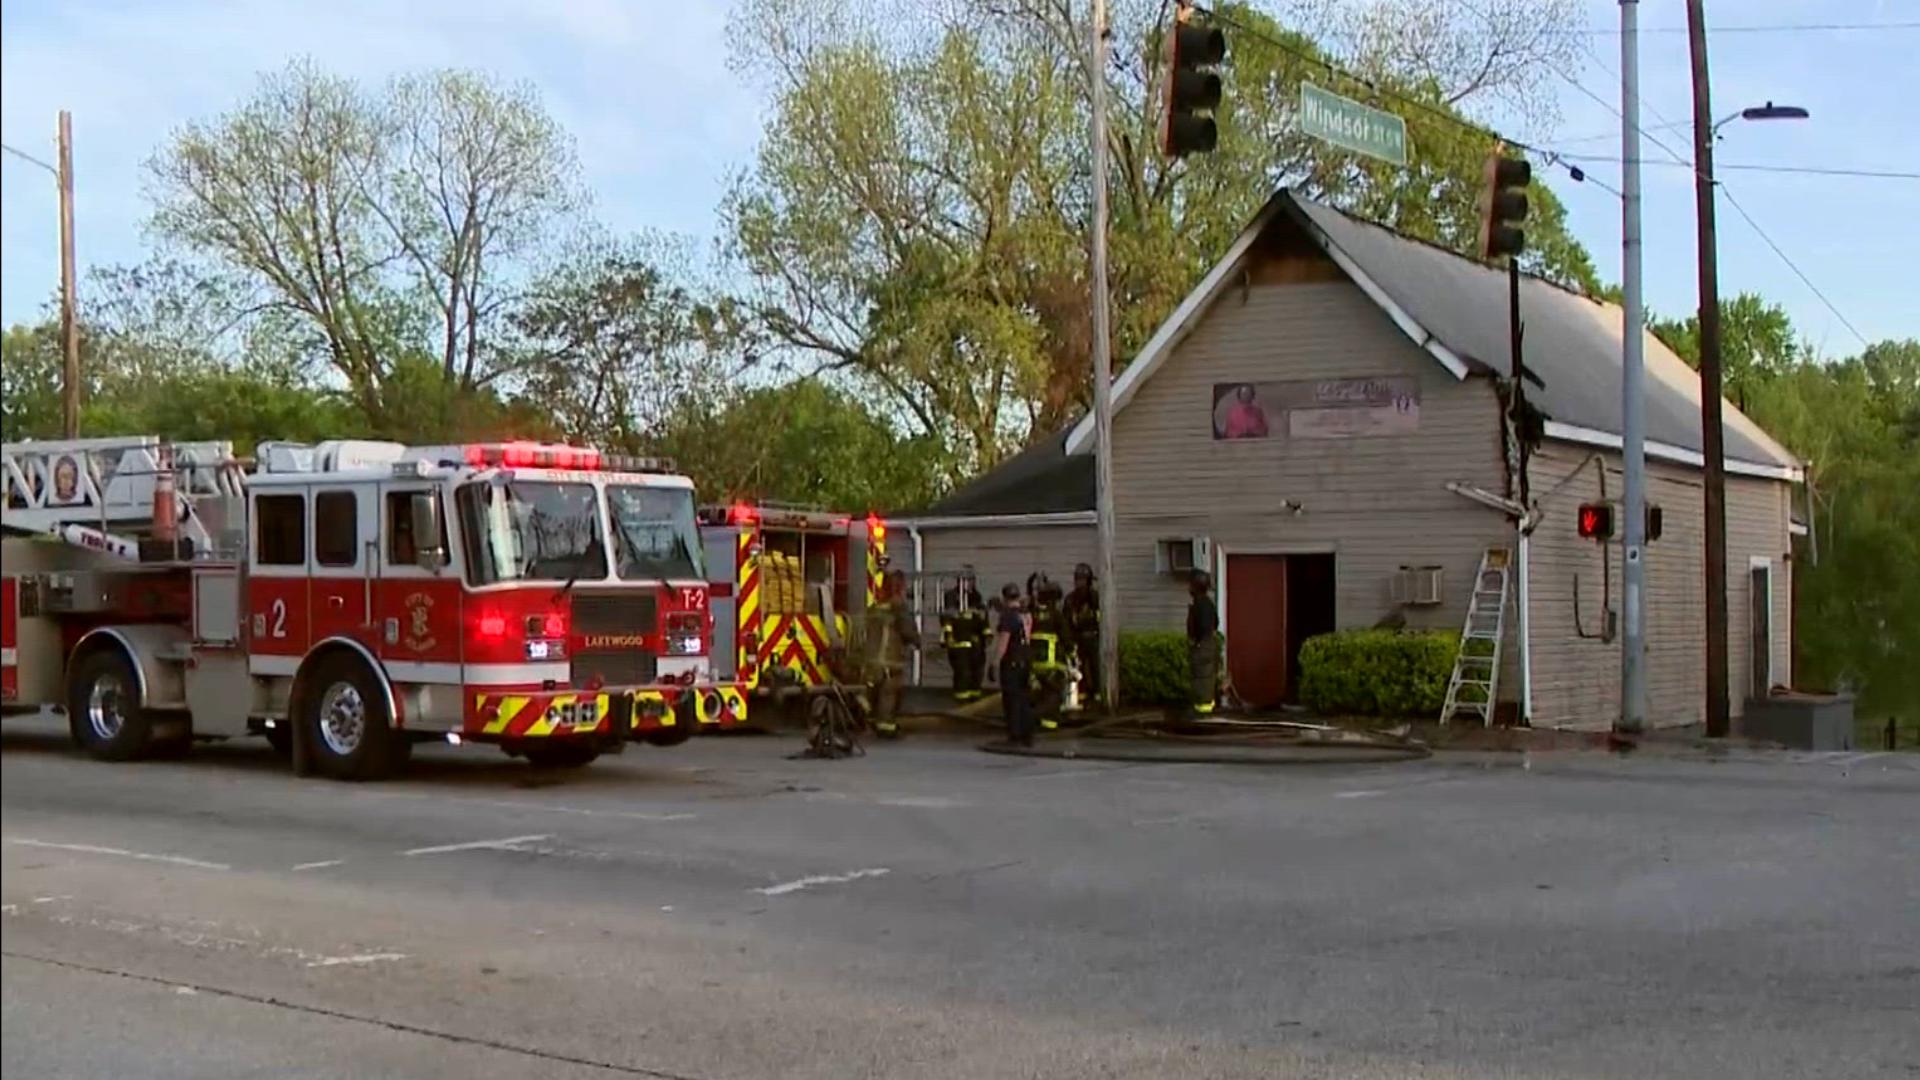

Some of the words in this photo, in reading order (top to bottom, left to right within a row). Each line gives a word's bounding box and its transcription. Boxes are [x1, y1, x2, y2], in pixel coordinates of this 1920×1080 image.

[682, 589, 704, 609] T-2
[272, 598, 286, 638] 2
[585, 635, 643, 648] LAKEWOOD
